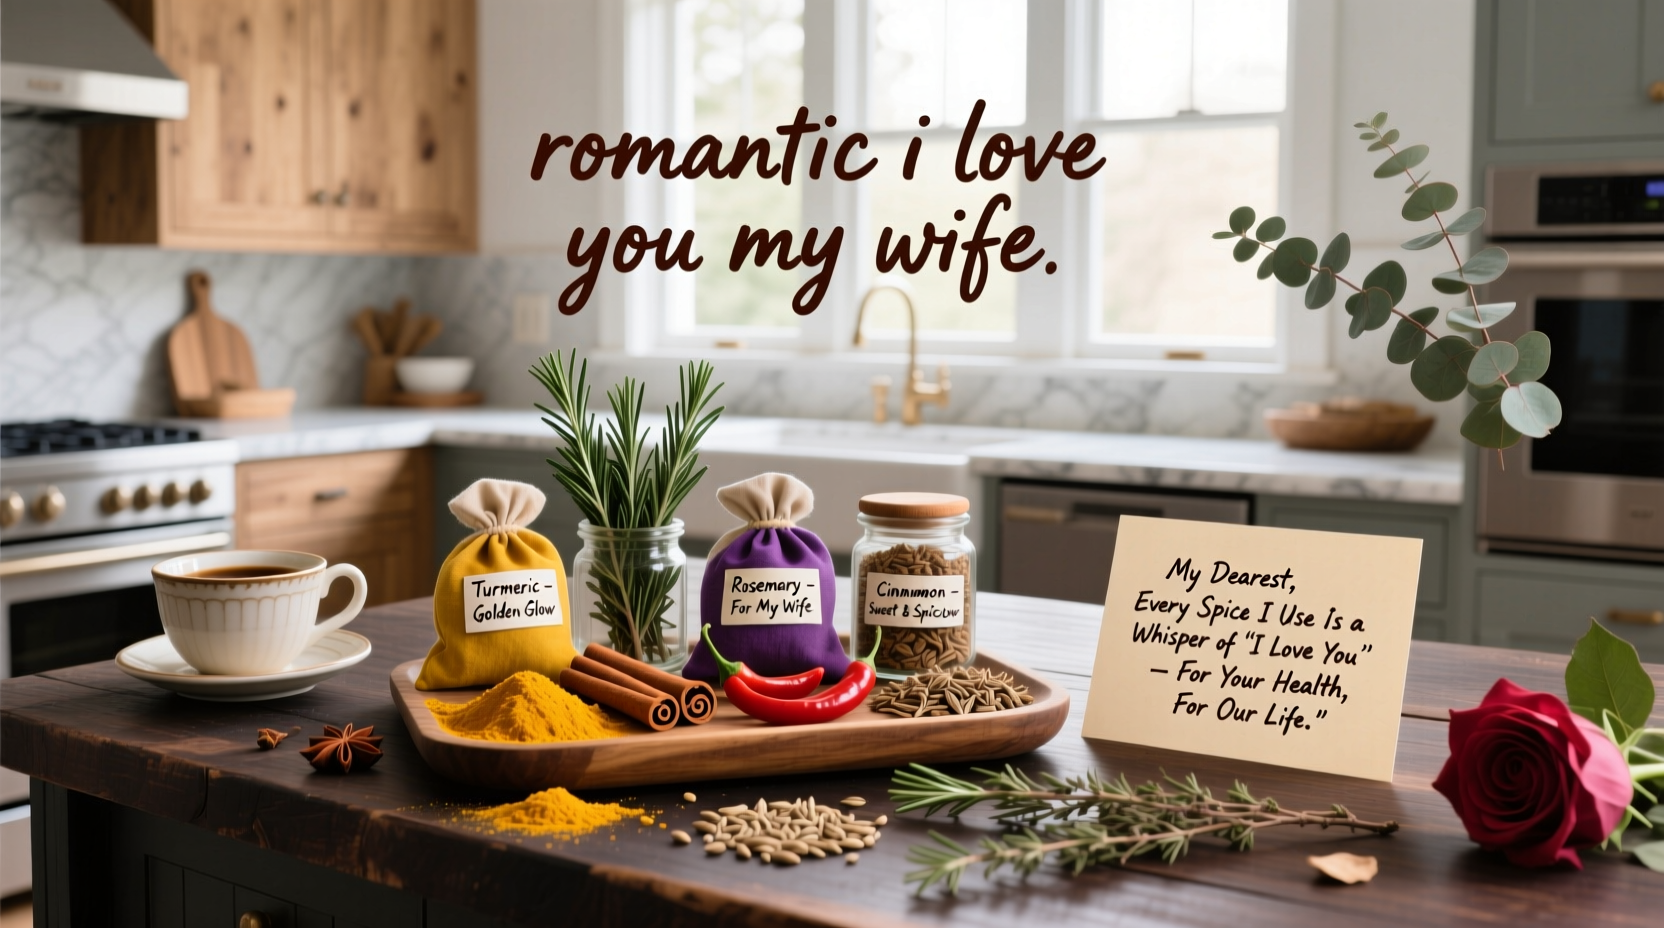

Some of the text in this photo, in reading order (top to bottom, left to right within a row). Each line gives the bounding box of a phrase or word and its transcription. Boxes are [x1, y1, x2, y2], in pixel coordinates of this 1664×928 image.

[471, 577, 540, 598] Turmeric
[731, 575, 801, 597] Rosemary
[1165, 557, 1297, 595] My Dearest,
[473, 599, 556, 623] Golden Glow
[730, 597, 814, 620] For My Wife
[1134, 590, 1191, 624] Every
[1196, 594, 1251, 627] Spice
[1257, 601, 1275, 624] I
[1279, 603, 1316, 628] Use
[1349, 618, 1366, 632] a
[1132, 621, 1211, 655] Whisper
[1215, 631, 1239, 660] of
[1268, 635, 1315, 661] Love
[1176, 659, 1213, 683] For
[1220, 664, 1266, 690] Your
[1271, 669, 1350, 705] Health,
[1172, 691, 1209, 716] For
[1216, 696, 1259, 724] Our
